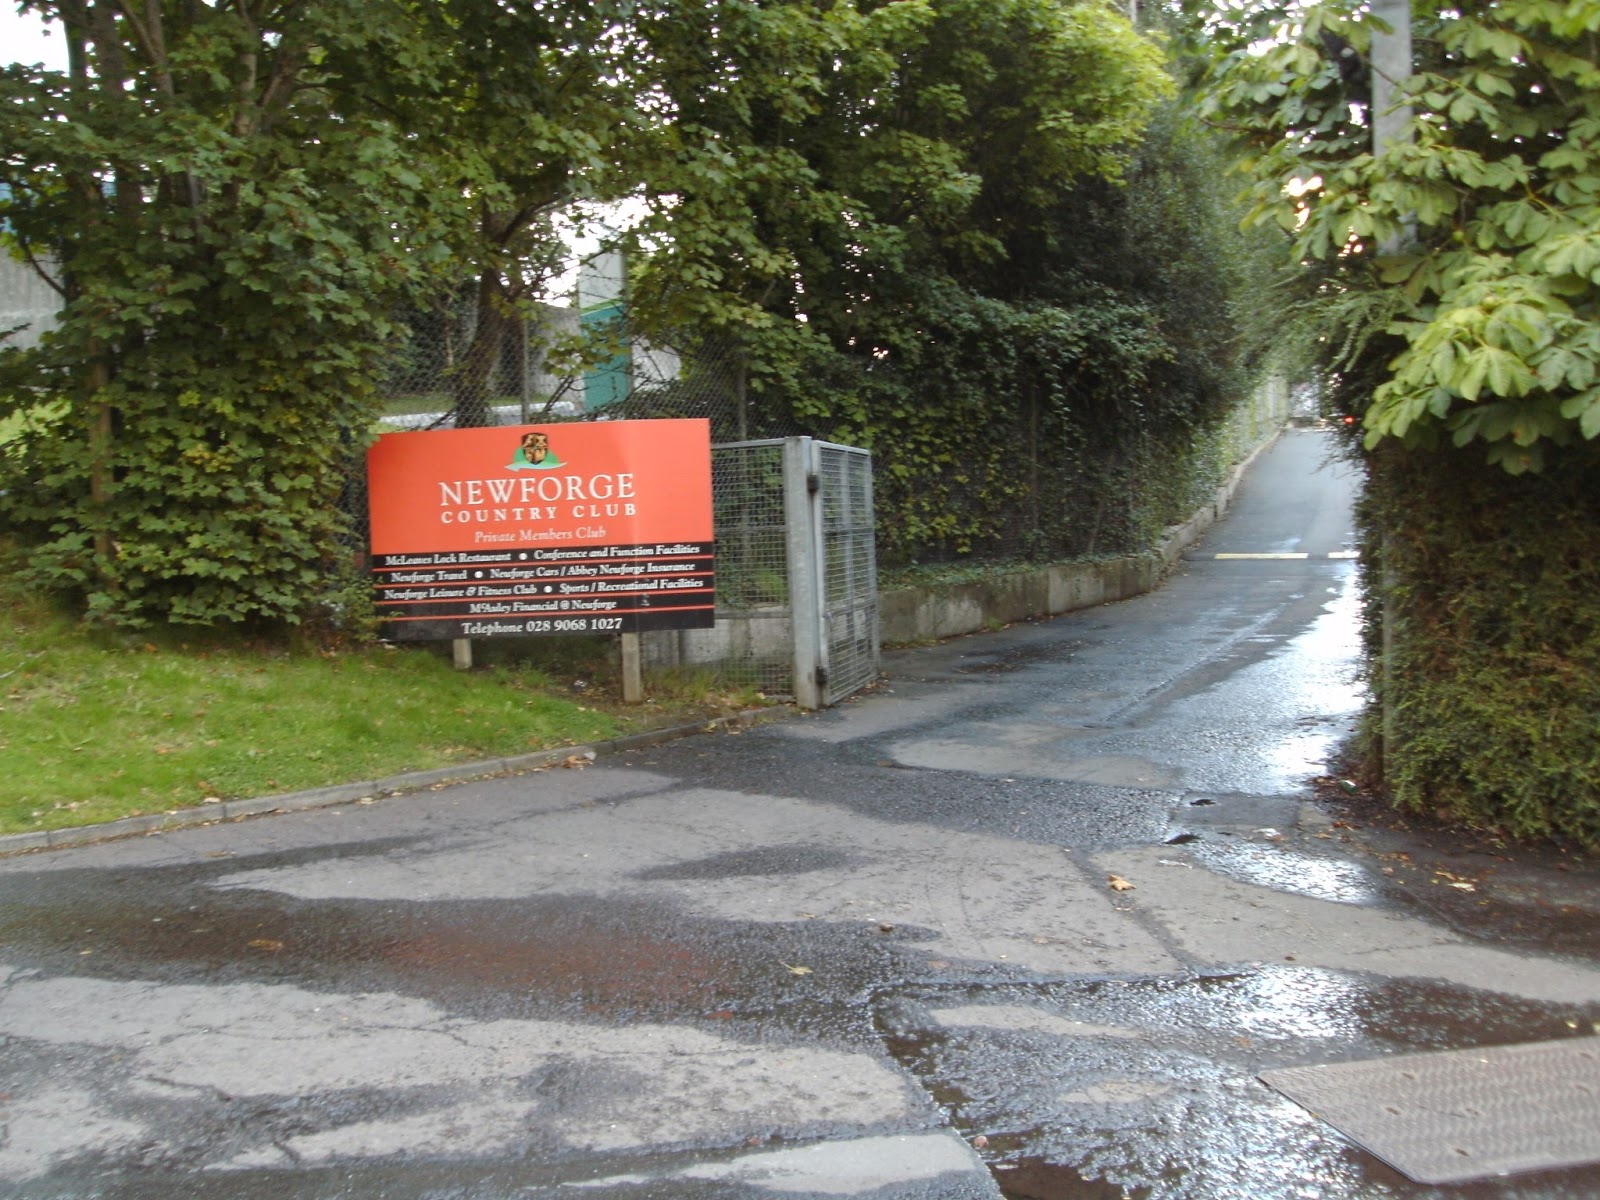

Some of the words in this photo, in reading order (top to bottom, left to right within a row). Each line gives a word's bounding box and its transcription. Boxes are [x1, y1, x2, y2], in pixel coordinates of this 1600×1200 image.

[438, 473, 636, 506] NEWFORGE
[441, 506, 557, 523] COUNTRY
[572, 503, 636, 518] CLUB
[474, 530, 515, 543] Private
[519, 528, 572, 541] Members
[575, 526, 606, 539] Club
[458, 552, 512, 563] Restaurant
[534, 548, 588, 561] Conference
[589, 547, 608, 558] and
[609, 546, 654, 557] Function
[655, 544, 700, 555] Facilities
[390, 572, 435, 583] Newforge
[436, 570, 468, 581] Travel
[489, 568, 534, 579] Newforge
[536, 567, 559, 577] Cars
[566, 565, 598, 577] Abbey
[599, 563, 646, 575] Newforge
[647, 562, 695, 573] Insurance
[384, 589, 428, 600] Newforge
[429, 587, 464, 598] Leisure
[465, 586, 477, 596] &
[477, 586, 512, 596] Fitness
[513, 584, 538, 595] Club
[559, 582, 590, 595] Sports
[597, 580, 659, 592] Recreational
[659, 578, 704, 589] Facilities
[512, 600, 558, 612] Financial
[559, 599, 570, 610] @
[571, 598, 617, 611] Newforge
[461, 621, 523, 636] Telephone
[526, 620, 551, 633] 028
[554, 618, 587, 632] 9068
[591, 617, 623, 630] 1027
